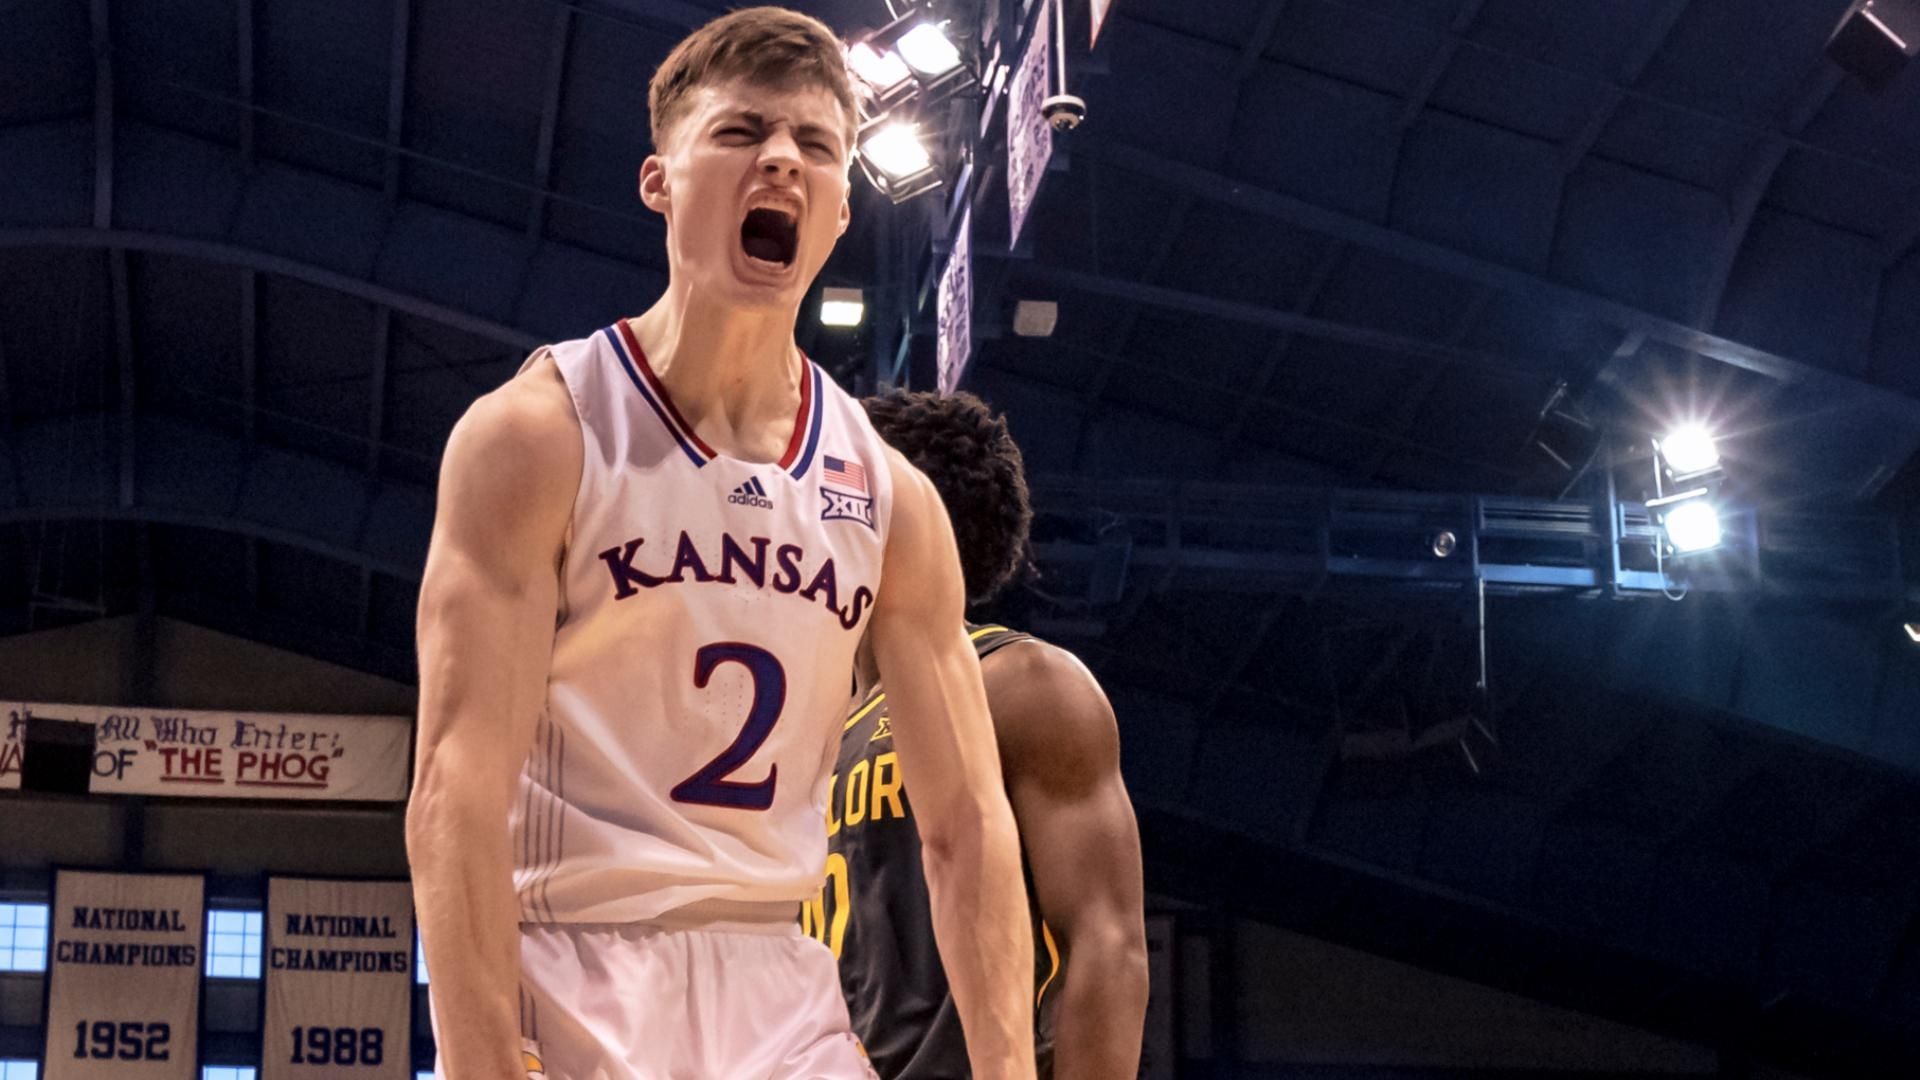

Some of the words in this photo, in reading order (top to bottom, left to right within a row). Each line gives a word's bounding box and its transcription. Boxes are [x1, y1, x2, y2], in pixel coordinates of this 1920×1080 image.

[728, 493, 774, 510] adidas
[598, 530, 873, 630] KANSAS
[99, 714, 141, 741] All
[670, 641, 787, 812] 2
[92, 748, 138, 780] OF
[143, 740, 223, 777] "THE
[236, 747, 345, 782] PHOG"
[826, 752, 905, 838] LOR
[72, 906, 186, 932] NATIONAL
[285, 913, 396, 938] NATIONAL
[56, 940, 196, 967] CHAMPIONS
[270, 947, 408, 973] CHAMPIONS
[73, 1020, 171, 1062] 1952
[289, 1026, 384, 1066] 1988
